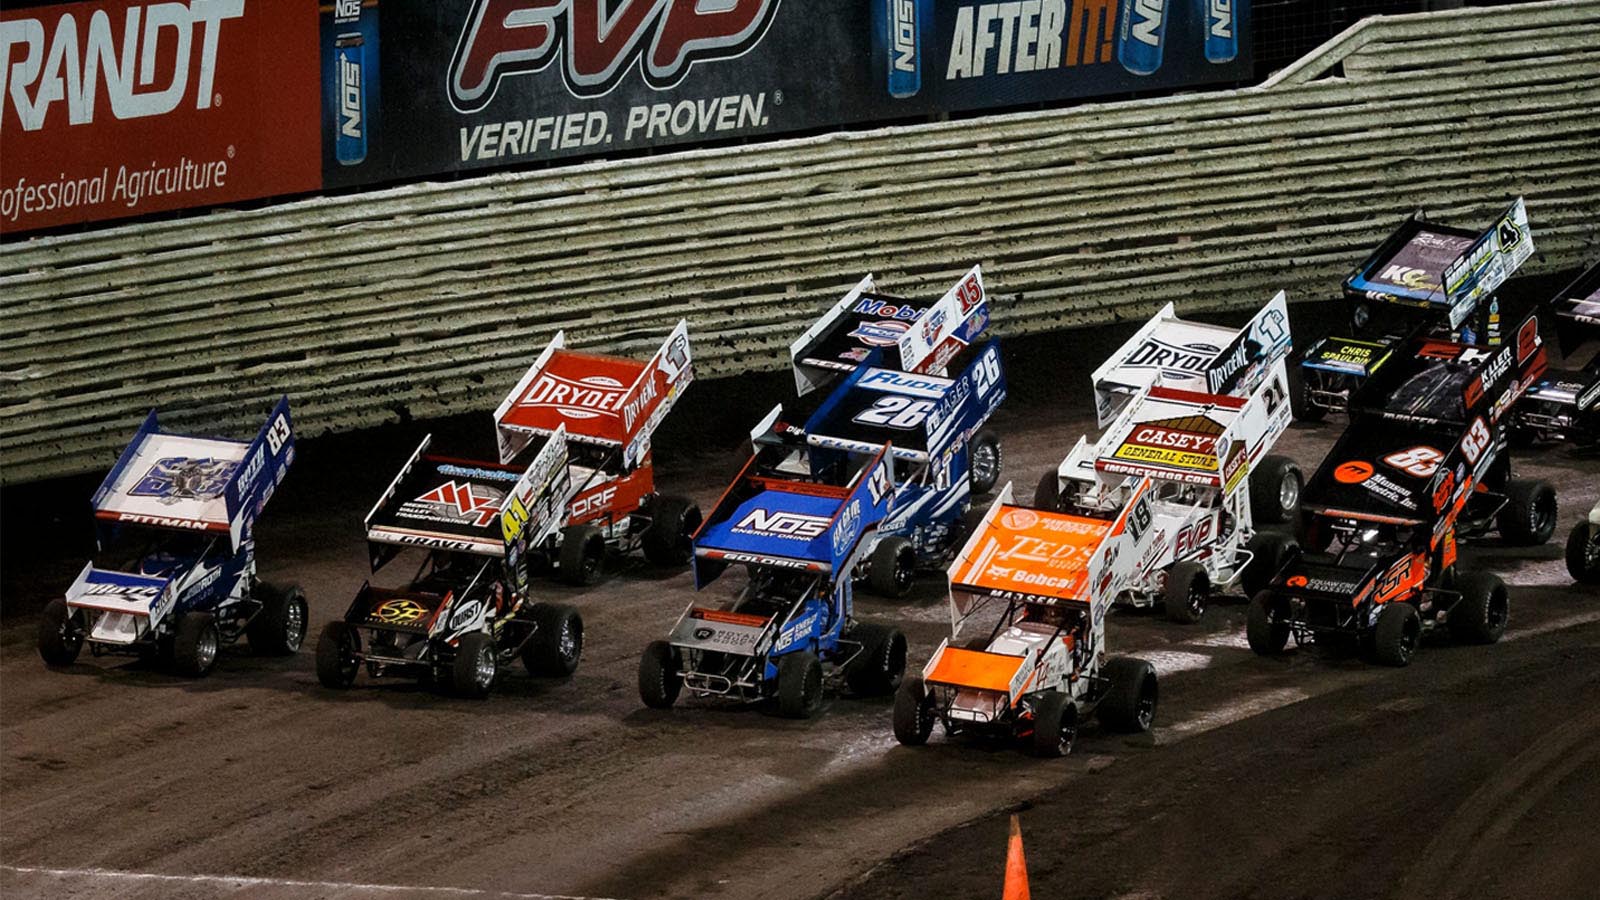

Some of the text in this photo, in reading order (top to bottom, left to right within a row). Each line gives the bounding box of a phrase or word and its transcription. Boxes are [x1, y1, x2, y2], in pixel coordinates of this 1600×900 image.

[335, 0, 361, 17] NOS
[946, 0, 1066, 80] AFTER
[341, 53, 361, 138] NOS
[460, 92, 769, 162] VERIFIED. PROVEN.
[0, 157, 227, 222] ofessional Agriculture
[956, 274, 983, 316] 15
[1208, 336, 1249, 396] DRYDENE
[1341, 345, 1372, 358] CHRIS
[1481, 345, 1511, 384] KLLER
[971, 347, 1001, 401] 26
[853, 397, 935, 430] 26
[1261, 375, 1288, 418] 21
[265, 412, 291, 457] 83
[1123, 446, 1177, 462] GENERAL
[1460, 416, 1490, 465] 83
[572, 486, 618, 518] DRF
[867, 460, 896, 508] 17
[118, 513, 209, 531] PITTMAN
[501, 495, 529, 547] 41
[730, 526, 812, 543] ENERGY DRINK
[735, 507, 833, 538] NOS
[1126, 496, 1152, 544] 18
[1175, 514, 1214, 561] FVP
[399, 535, 475, 551] GRAVEL
[723, 552, 808, 571] GOLOBIC
